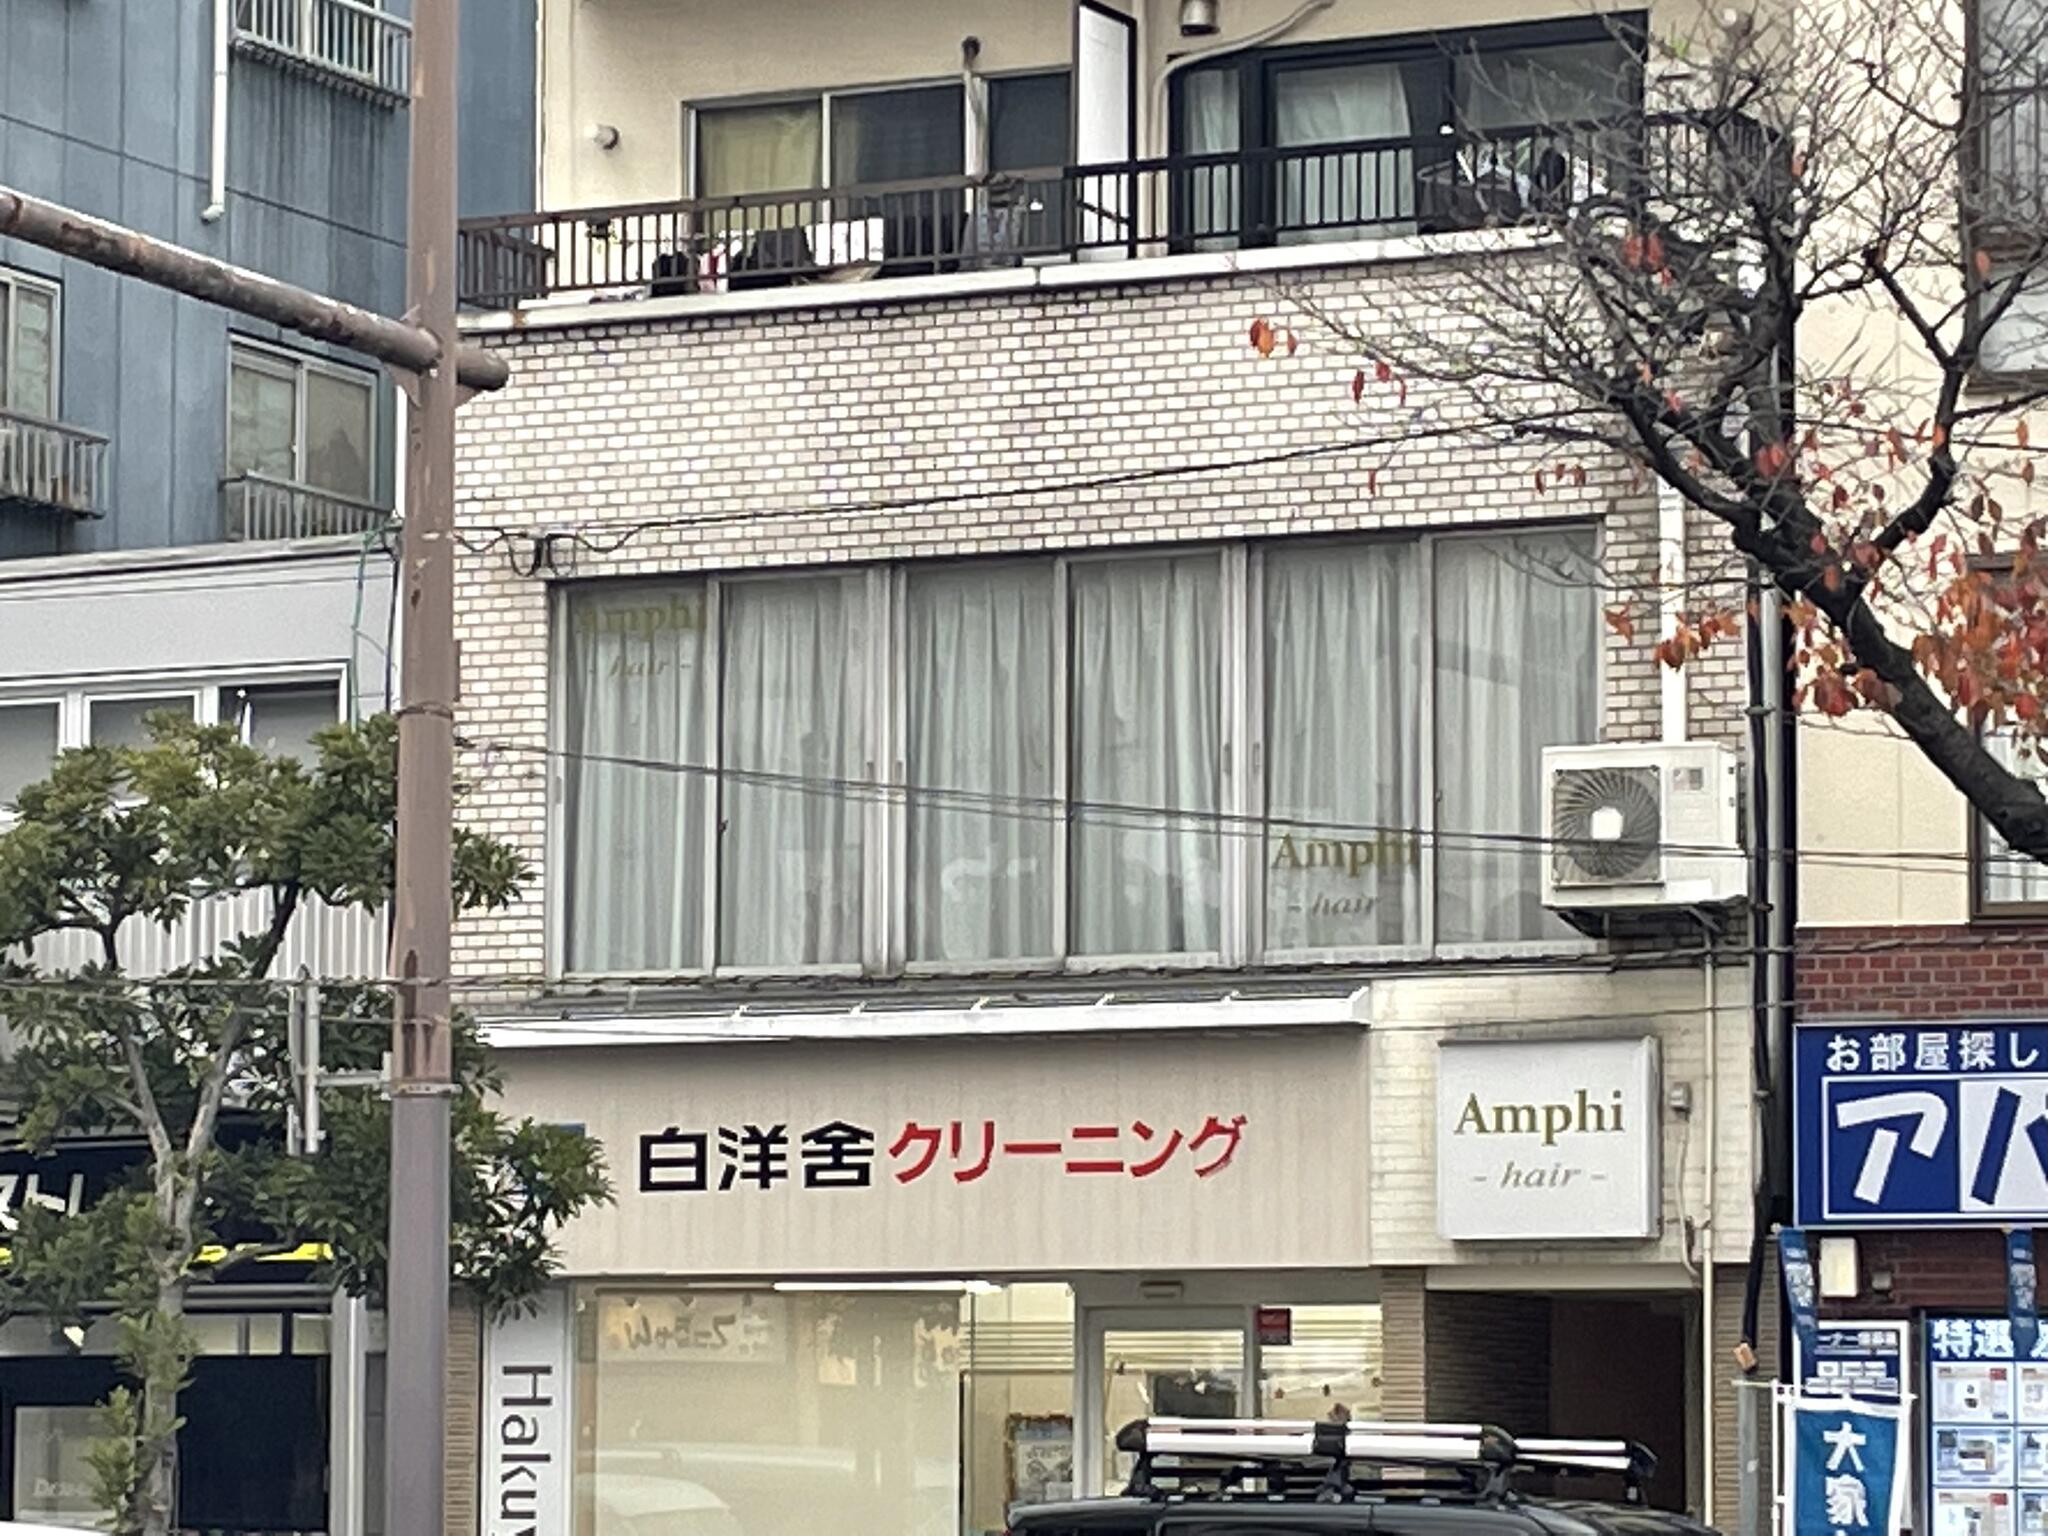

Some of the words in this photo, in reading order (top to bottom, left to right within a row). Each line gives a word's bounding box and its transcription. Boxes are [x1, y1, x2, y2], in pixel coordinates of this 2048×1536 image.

[1271, 828, 1419, 879] Amphi
[1826, 1030, 2039, 1072] お部屋探し
[1453, 1088, 1625, 1147] Amphi
[1500, 1161, 1582, 1189] hair
[1933, 1319, 2048, 1359] 特選
[494, 1364, 553, 1536] Haku
[1822, 1421, 1870, 1536] 大家
